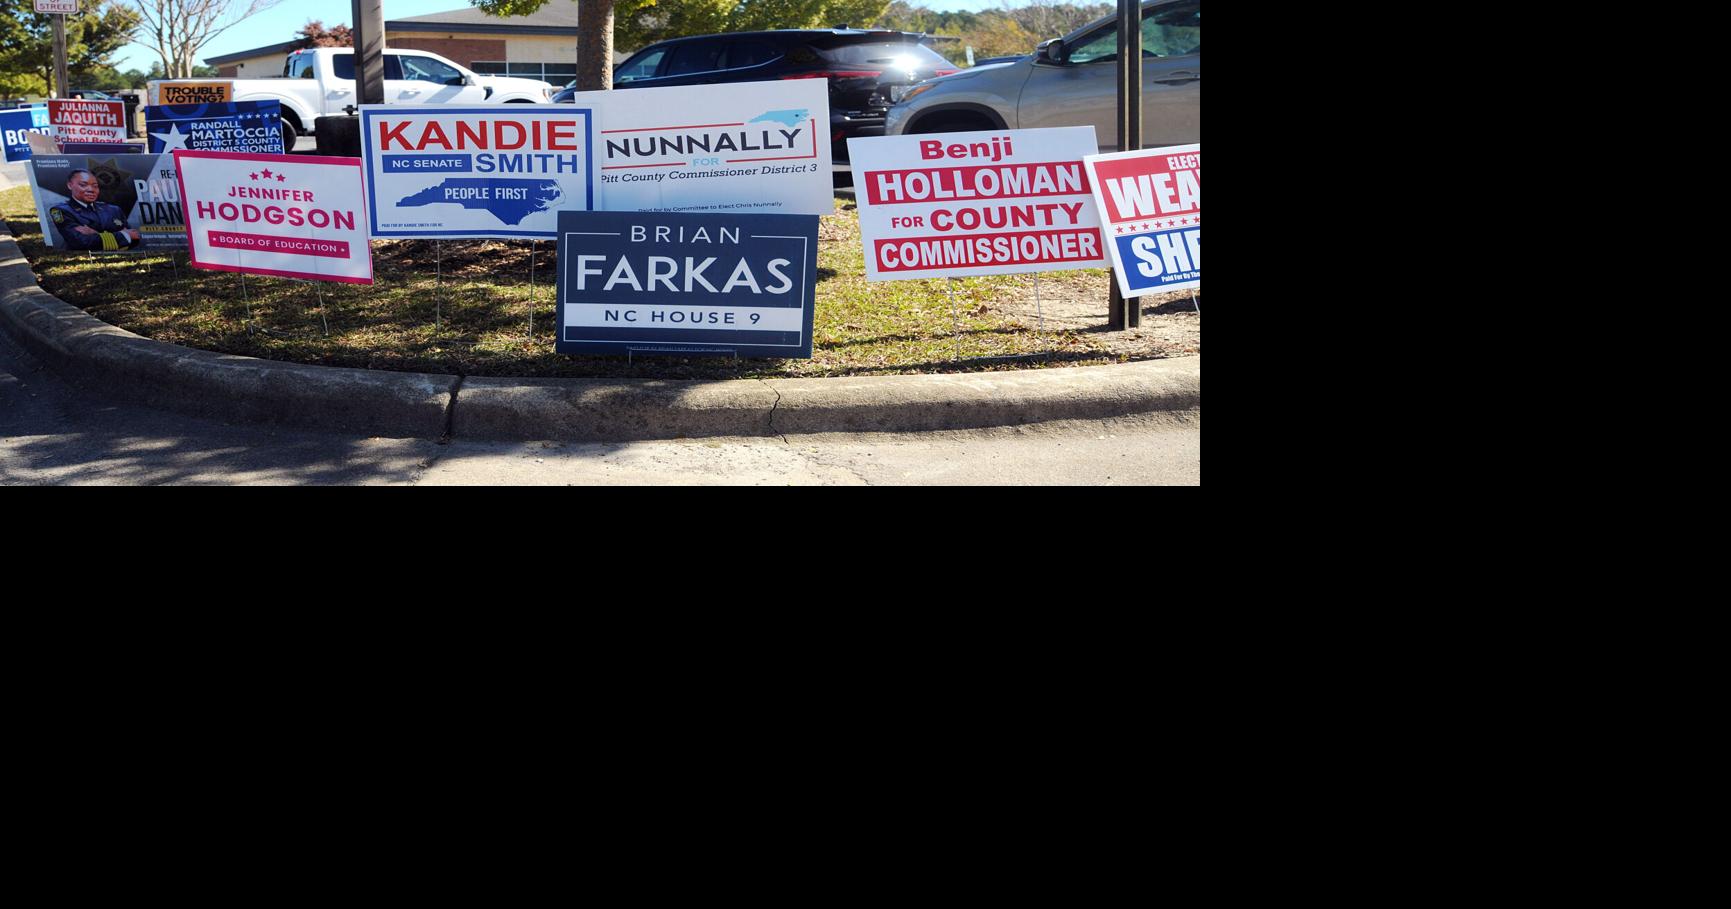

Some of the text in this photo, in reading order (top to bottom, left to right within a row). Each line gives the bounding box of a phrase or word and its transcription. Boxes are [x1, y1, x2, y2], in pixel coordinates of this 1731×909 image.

[164, 87, 224, 95] TROUBLE
[165, 95, 224, 104] VOTING?
[60, 102, 110, 112] JULIANNA
[55, 112, 117, 125] JAQUITH
[191, 121, 242, 130] RANDALL
[80, 128, 116, 138] County
[192, 127, 280, 140] MARTOCCIA
[379, 120, 577, 150] KANDIE
[606, 128, 801, 158] NUNNALLY
[920, 136, 1013, 162] Benji
[392, 159, 462, 168] NC SENATE
[476, 154, 578, 174] SMITH
[692, 157, 720, 167] FOR
[601, 173, 619, 183] Pitt
[622, 172, 665, 183] County
[669, 166, 758, 180] Commissioner
[761, 164, 807, 175] District
[134, 180, 180, 202] PAU
[877, 164, 1082, 202] HOLLOMAN
[228, 186, 314, 202] JENNIFER
[445, 188, 528, 199] PEOPLE FIRST
[1105, 169, 1200, 219] WEA
[139, 202, 184, 224] DAN
[196, 201, 355, 230] HODGSON
[892, 202, 1084, 231] FOR COUNTY
[220, 236, 254, 245] BOARD
[275, 241, 337, 252] EDUCATION
[631, 226, 740, 244] BRIAN
[880, 232, 1099, 269] COMMISSIONER
[576, 254, 793, 294] FARKAS
[604, 310, 761, 324] NC HOUSE 9
